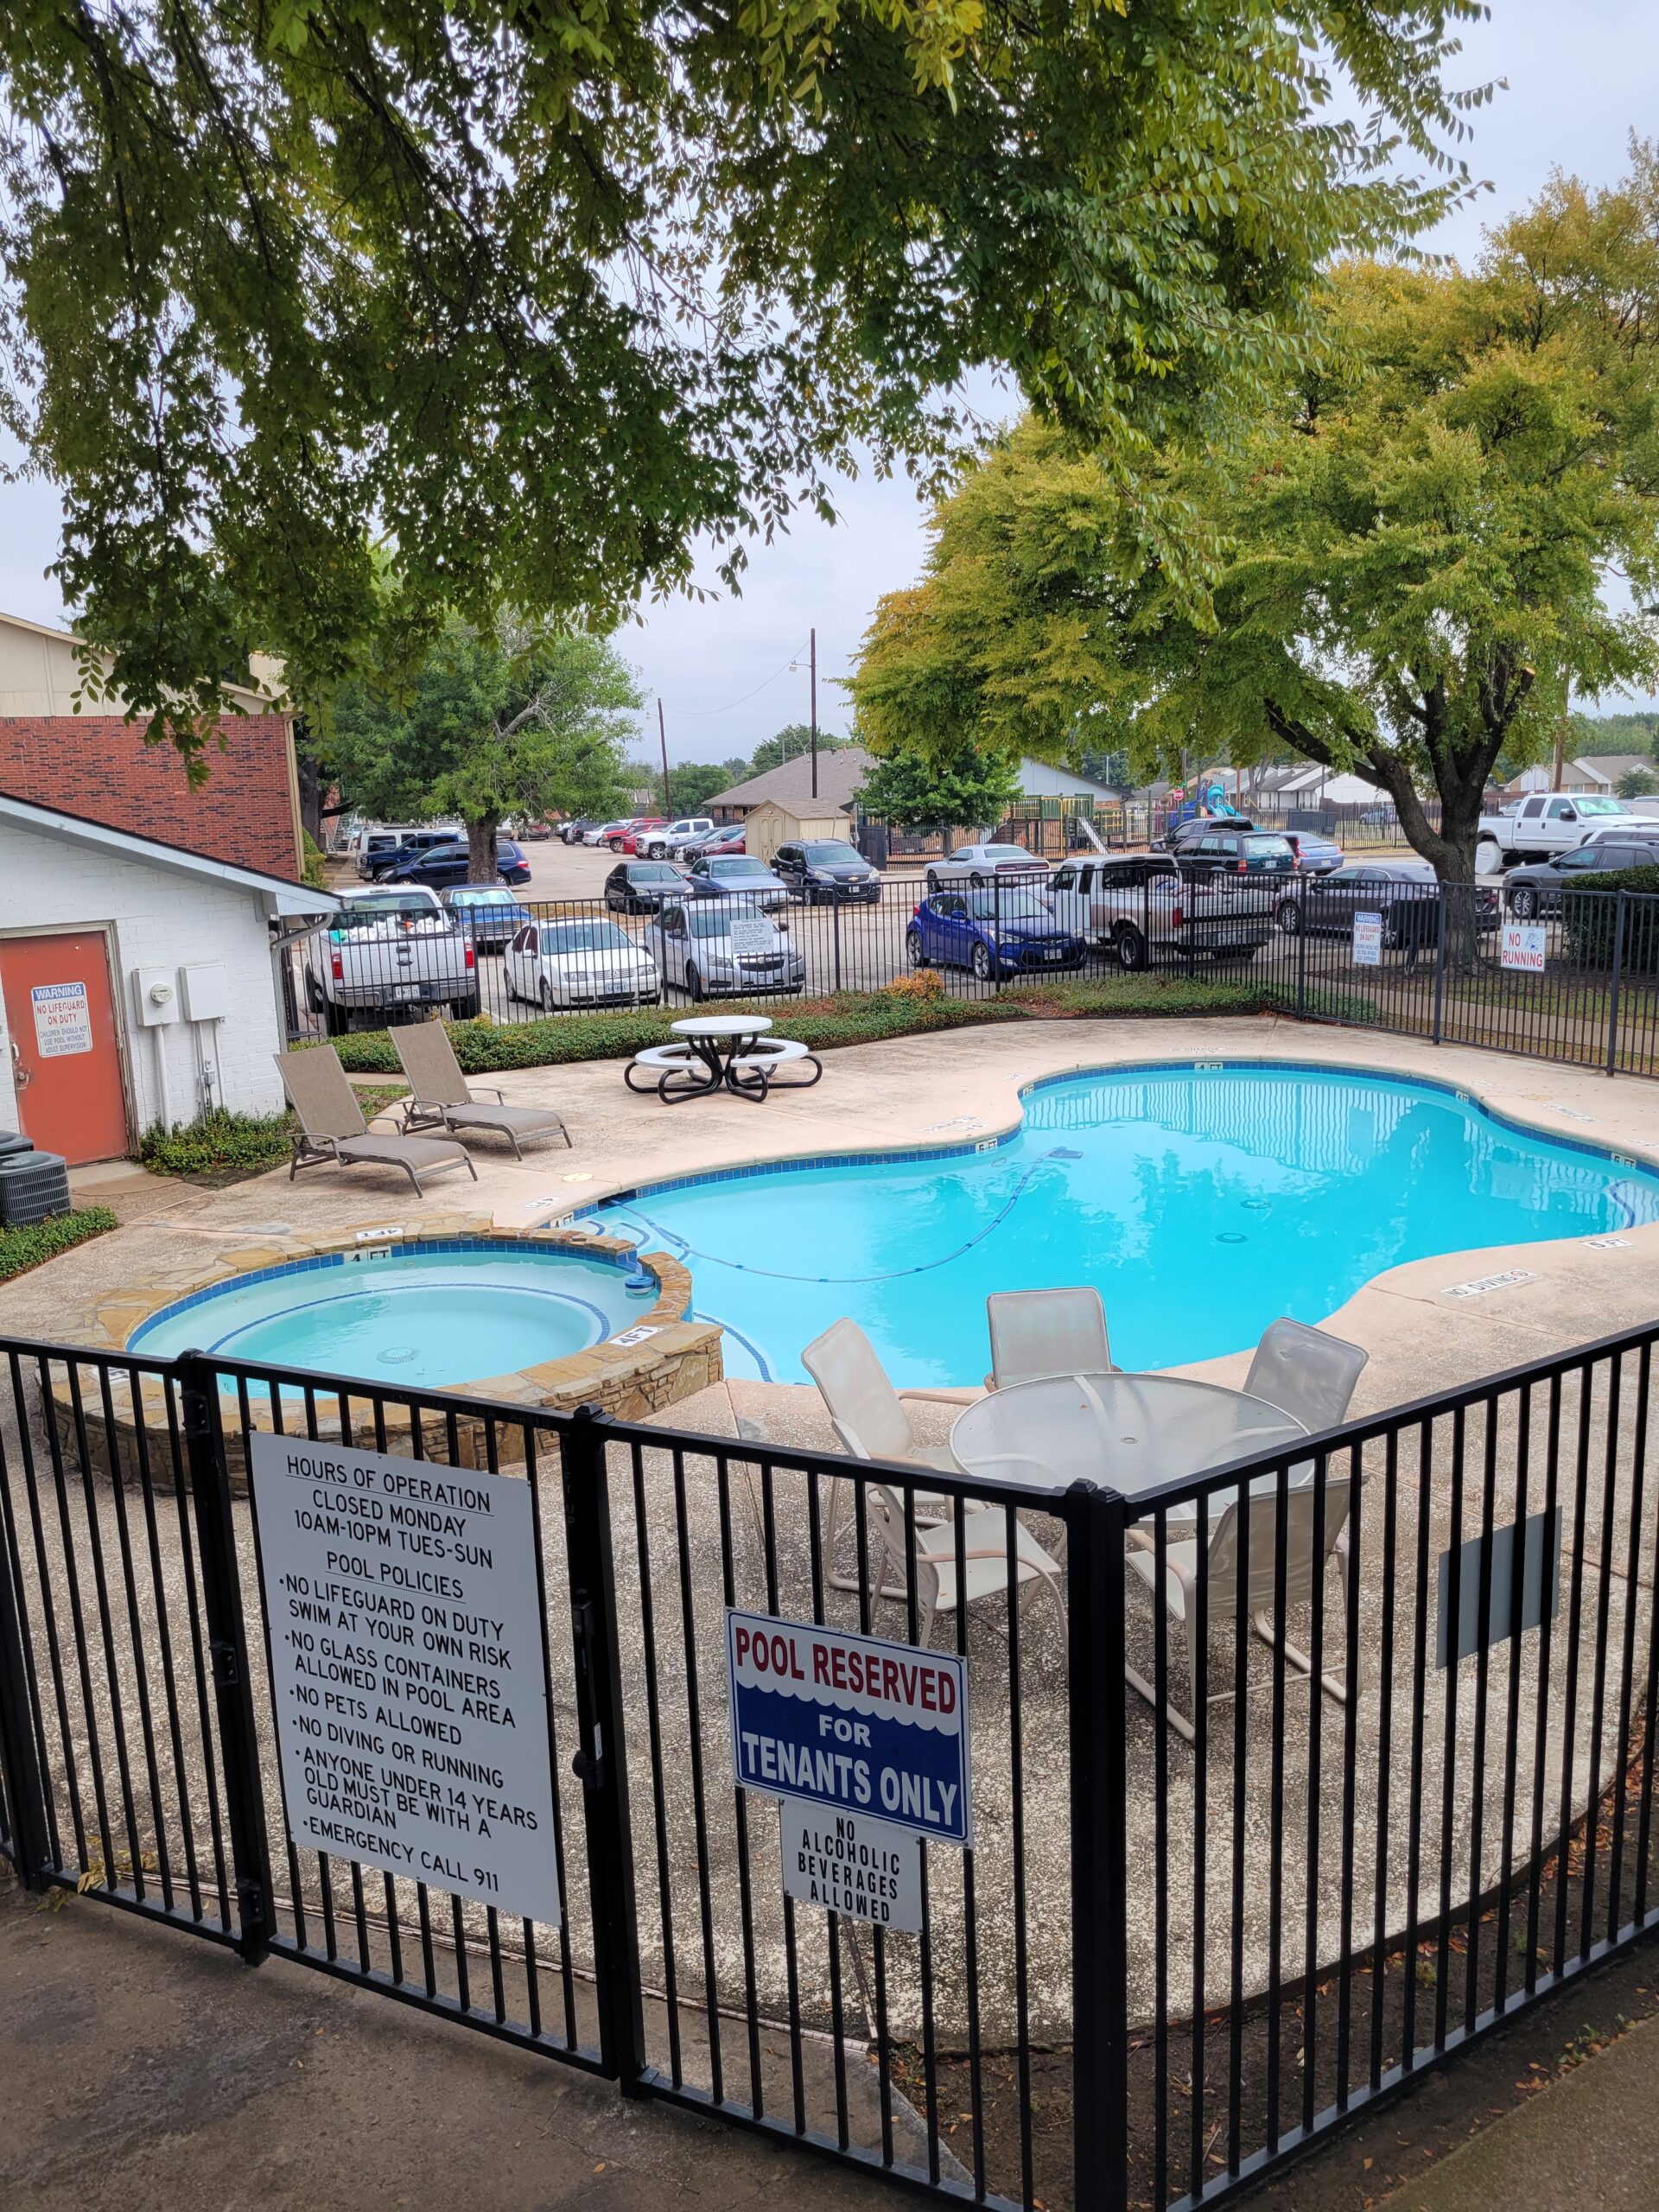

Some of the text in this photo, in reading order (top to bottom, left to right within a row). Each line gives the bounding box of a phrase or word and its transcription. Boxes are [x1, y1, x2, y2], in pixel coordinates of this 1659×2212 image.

[1357, 913, 1380, 924] WARNING
[1509, 932, 1521, 947] NO
[1503, 950, 1543, 968] RUNNING
[35, 985, 82, 1000] WARNING
[36, 1000, 85, 1014] NO LIFEGUARD
[39, 1028, 60, 1039] CHILDREN
[61, 1027, 79, 1036] SHOULD
[48, 1013, 77, 1026] ON DUTY
[54, 1036, 66, 1045] POOL
[67, 1033, 86, 1042] WITHOUT
[350, 1249, 390, 1262] 4 FT
[1604, 1238, 1629, 1247] FT
[1444, 1274, 1518, 1297] NO DIVING
[287, 1455, 491, 1512] HOURS OF OPERATION
[313, 1490, 467, 1537] CLOSED MONDAY
[295, 1510, 493, 1569] 10AM-10PM TUES-SUN
[327, 1551, 463, 1599] POOL POLICIES
[286, 1573, 504, 1641] NO LIFEGUARD ON DUTY
[289, 1599, 512, 1670] SWIM AT YOUR OWN RISK
[291, 1630, 500, 1699] NO GLASS CONTAINERS
[735, 1627, 956, 1714] POOL RESERVED
[296, 1654, 516, 1728] ALLOWED IN POOL AREA
[296, 1684, 461, 1745] NO PETS ALLOWED
[819, 1714, 871, 1748] FOR
[299, 1714, 504, 1789] NO DIVING OR RUNNING
[304, 1746, 538, 1830] ANYONE UNDER 14 YEARS
[741, 1732, 957, 1826] TENANTS ONLY
[305, 1767, 492, 1839] OLD MUST BE WITH A
[307, 1788, 397, 1829] GUARDIAN
[836, 1816, 855, 1840] NO
[309, 1816, 499, 1892] EMERGENCY CALL 911
[802, 1829, 900, 1875] ALCOHOLIC
[798, 1852, 898, 1900] BEVERAGES
[810, 1880, 889, 1922] ALLOWED
